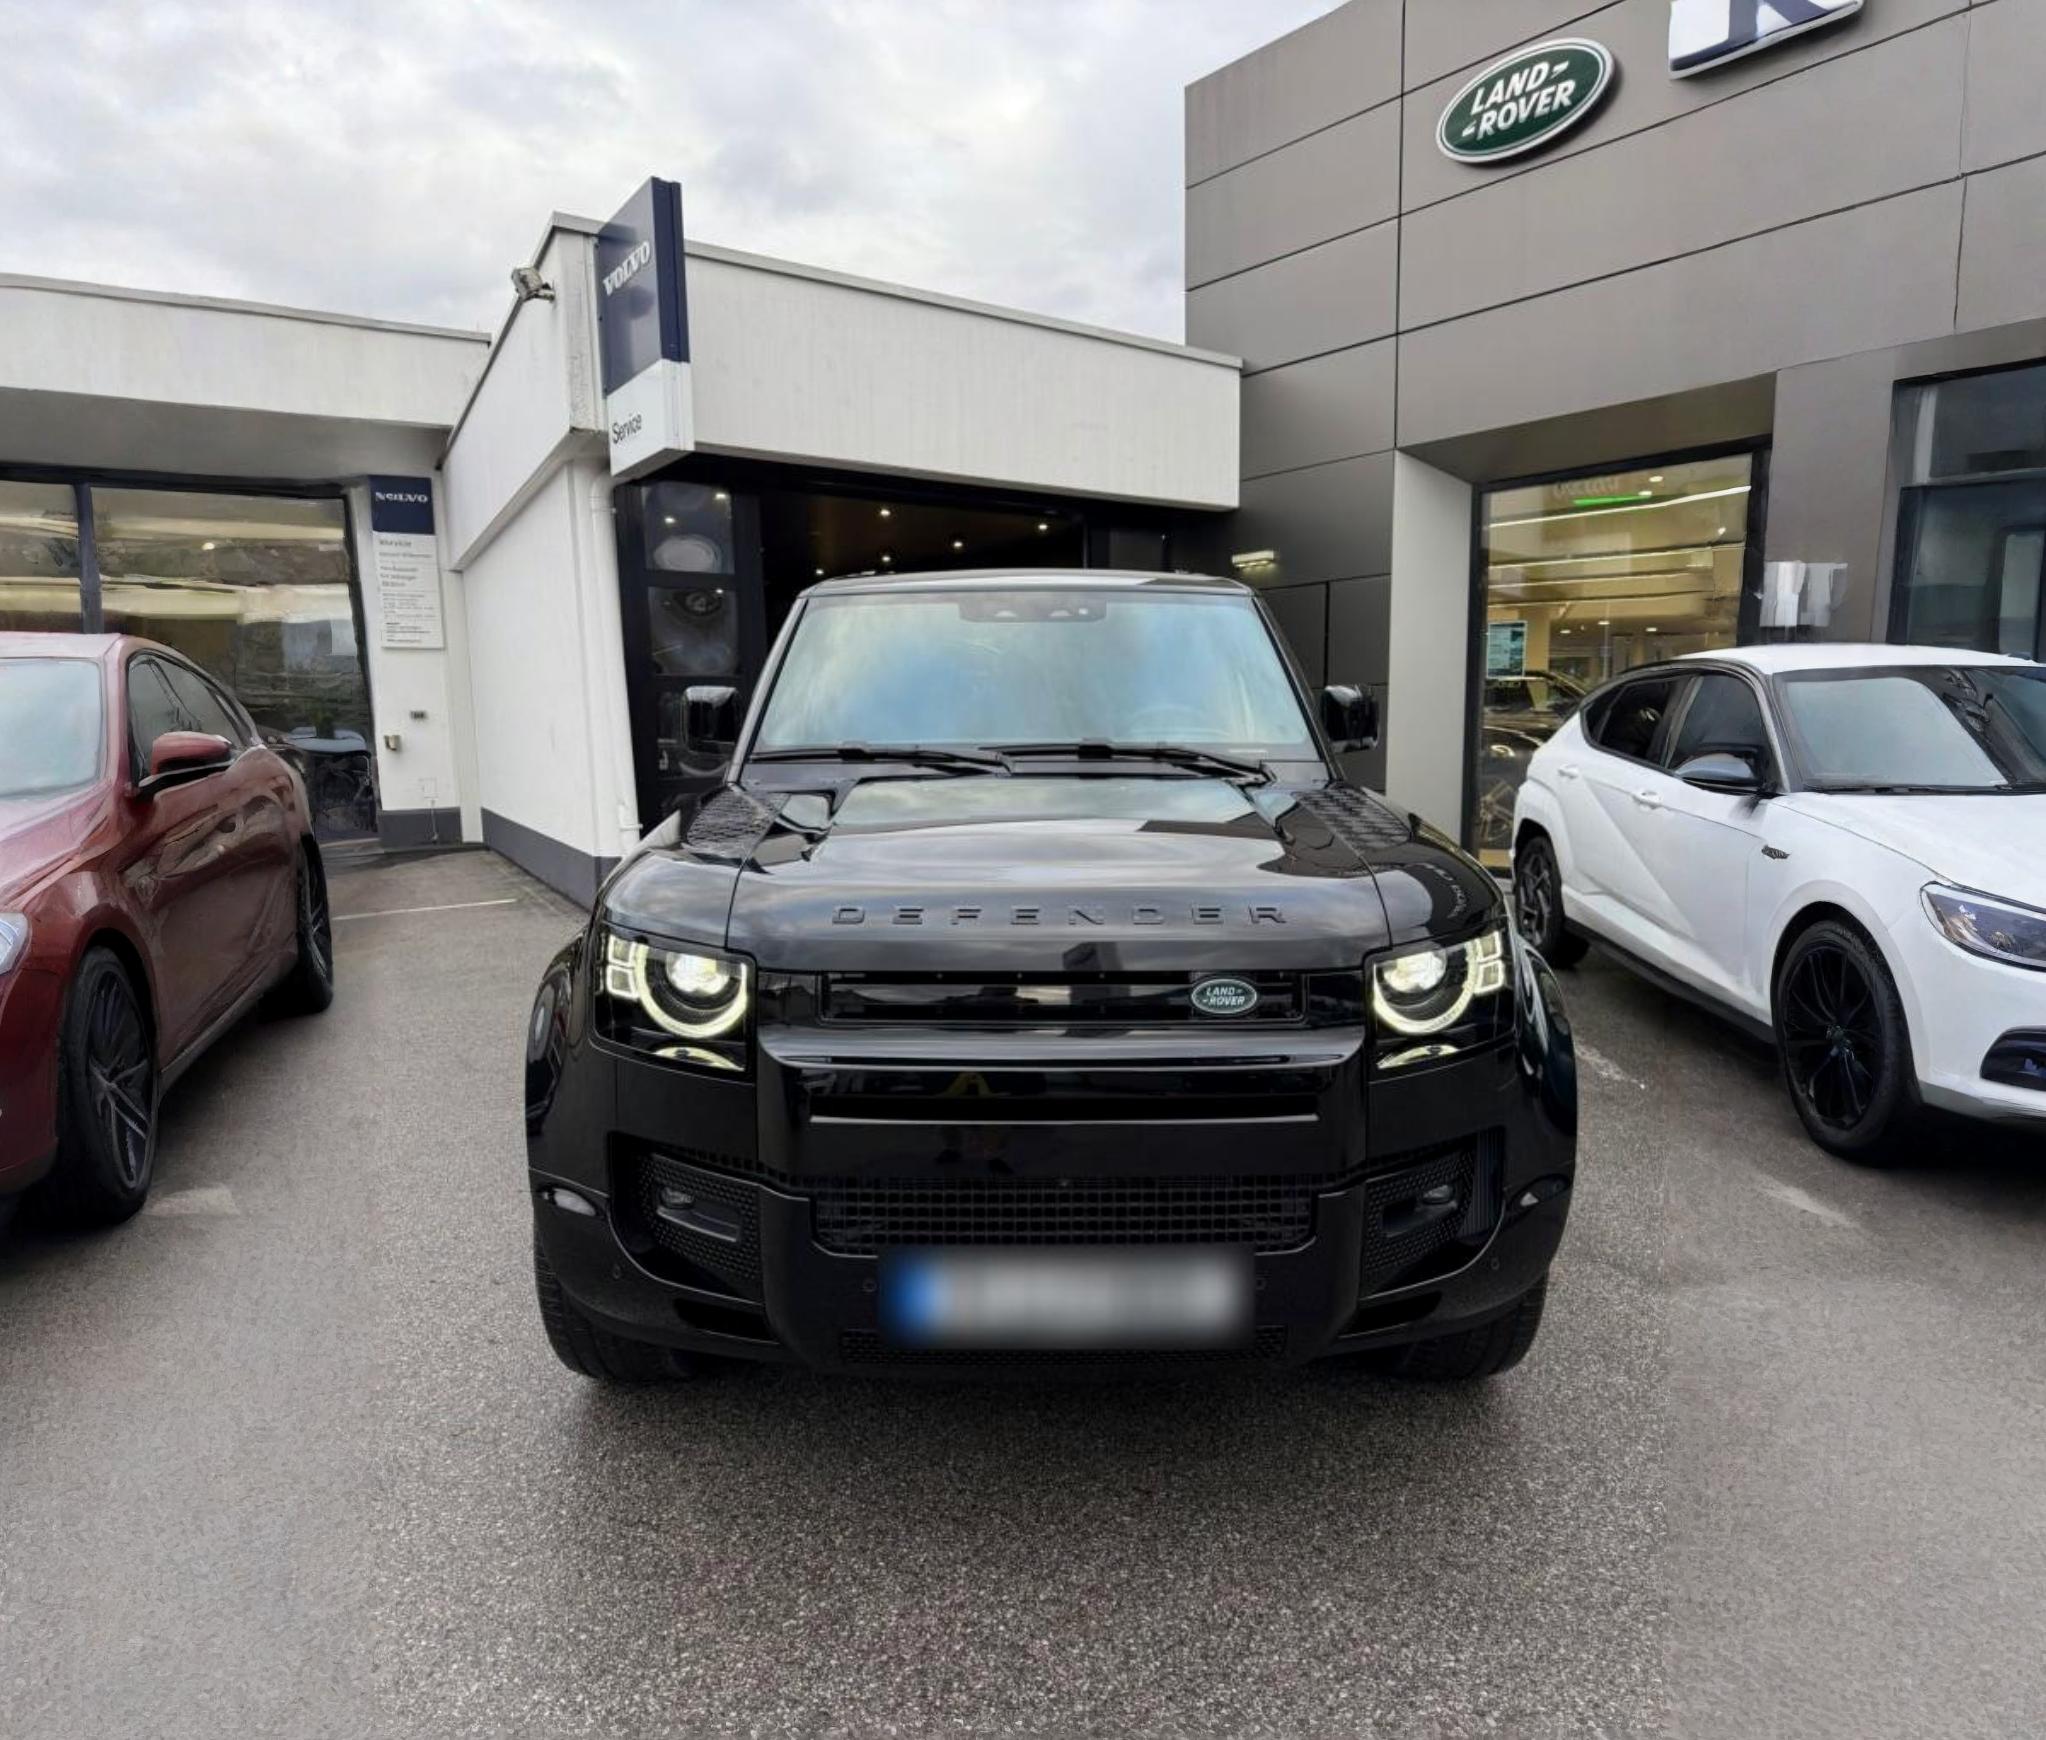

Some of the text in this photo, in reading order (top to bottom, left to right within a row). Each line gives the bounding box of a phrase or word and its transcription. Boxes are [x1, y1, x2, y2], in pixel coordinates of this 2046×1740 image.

[1470, 61, 1550, 116] LAND
[1476, 79, 1577, 141] ROVER
[602, 241, 651, 297] VOLVO
[611, 413, 643, 445] Service
[832, 905, 1287, 926] DEFENDER
[1206, 986, 1236, 996] LAND
[1208, 995, 1246, 1006] ROVER
